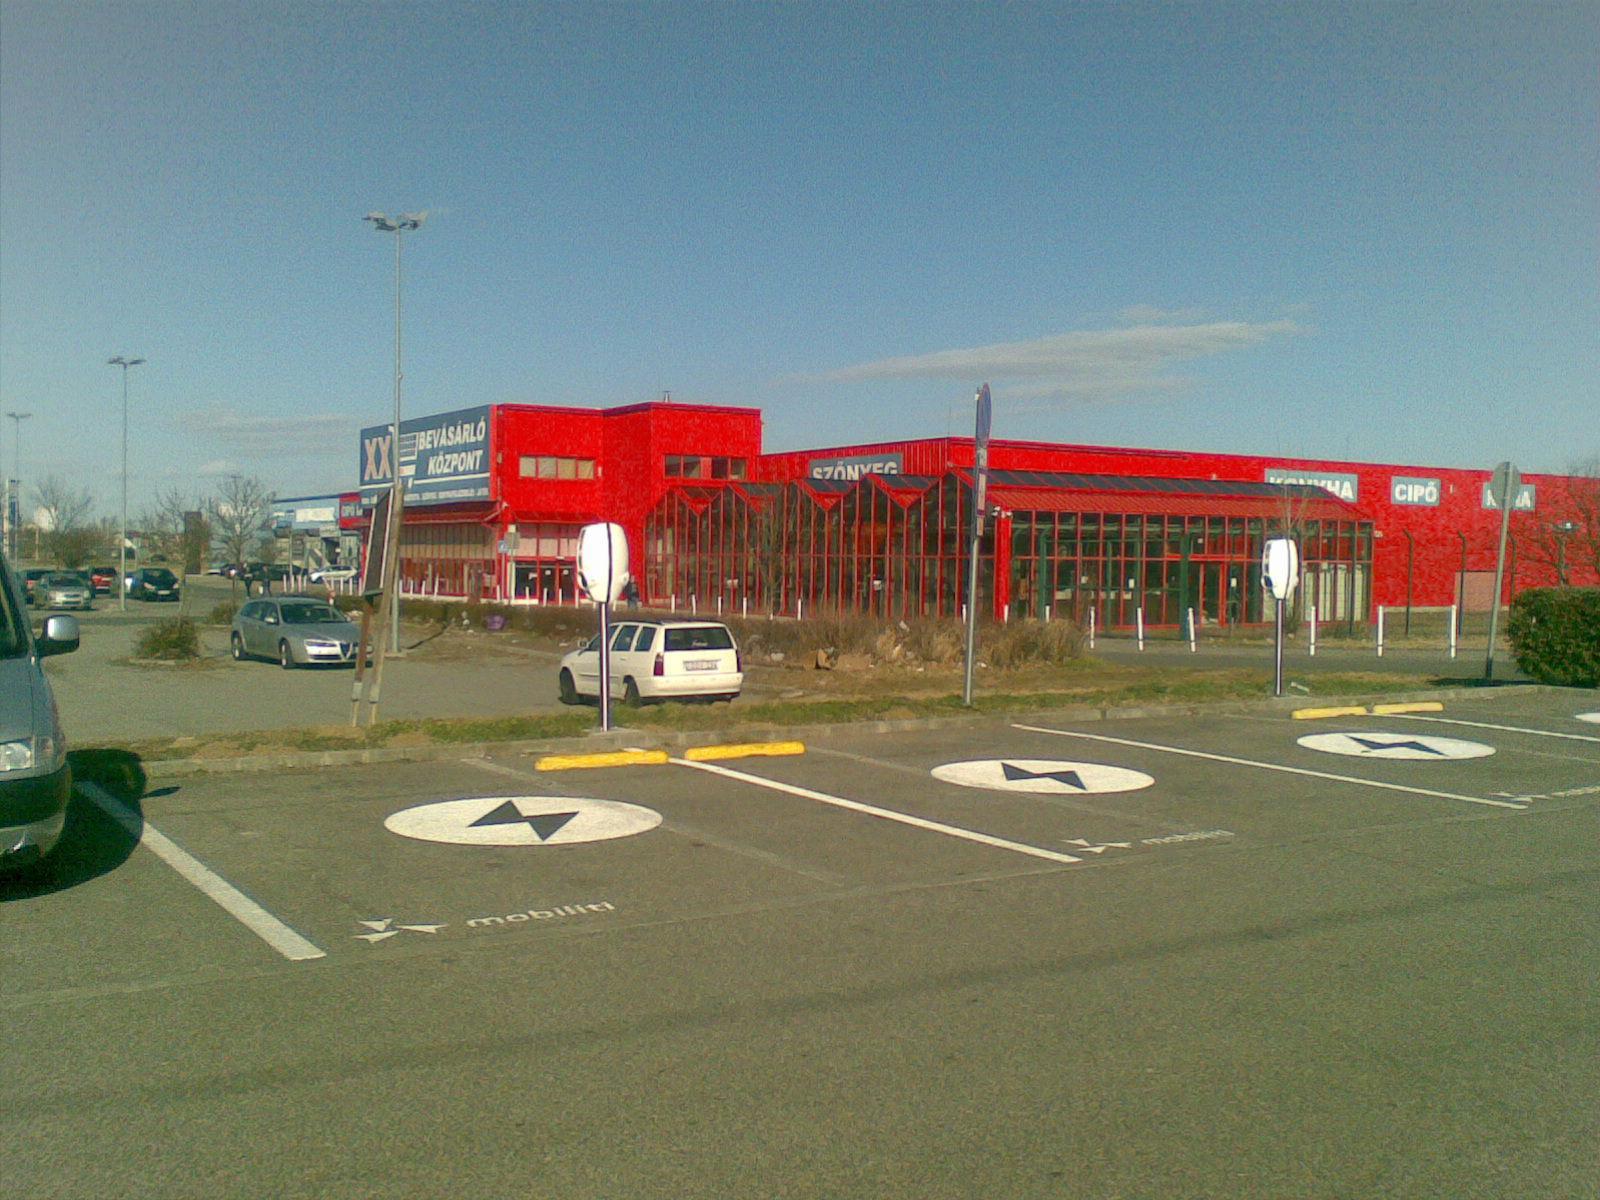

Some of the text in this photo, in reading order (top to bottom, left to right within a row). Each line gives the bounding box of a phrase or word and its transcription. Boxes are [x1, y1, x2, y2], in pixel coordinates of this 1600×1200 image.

[418, 416, 486, 450] BEVÁSÁRLÓ
[1395, 481, 1437, 502] CIPŐ
[467, 901, 615, 927] mobiliti
